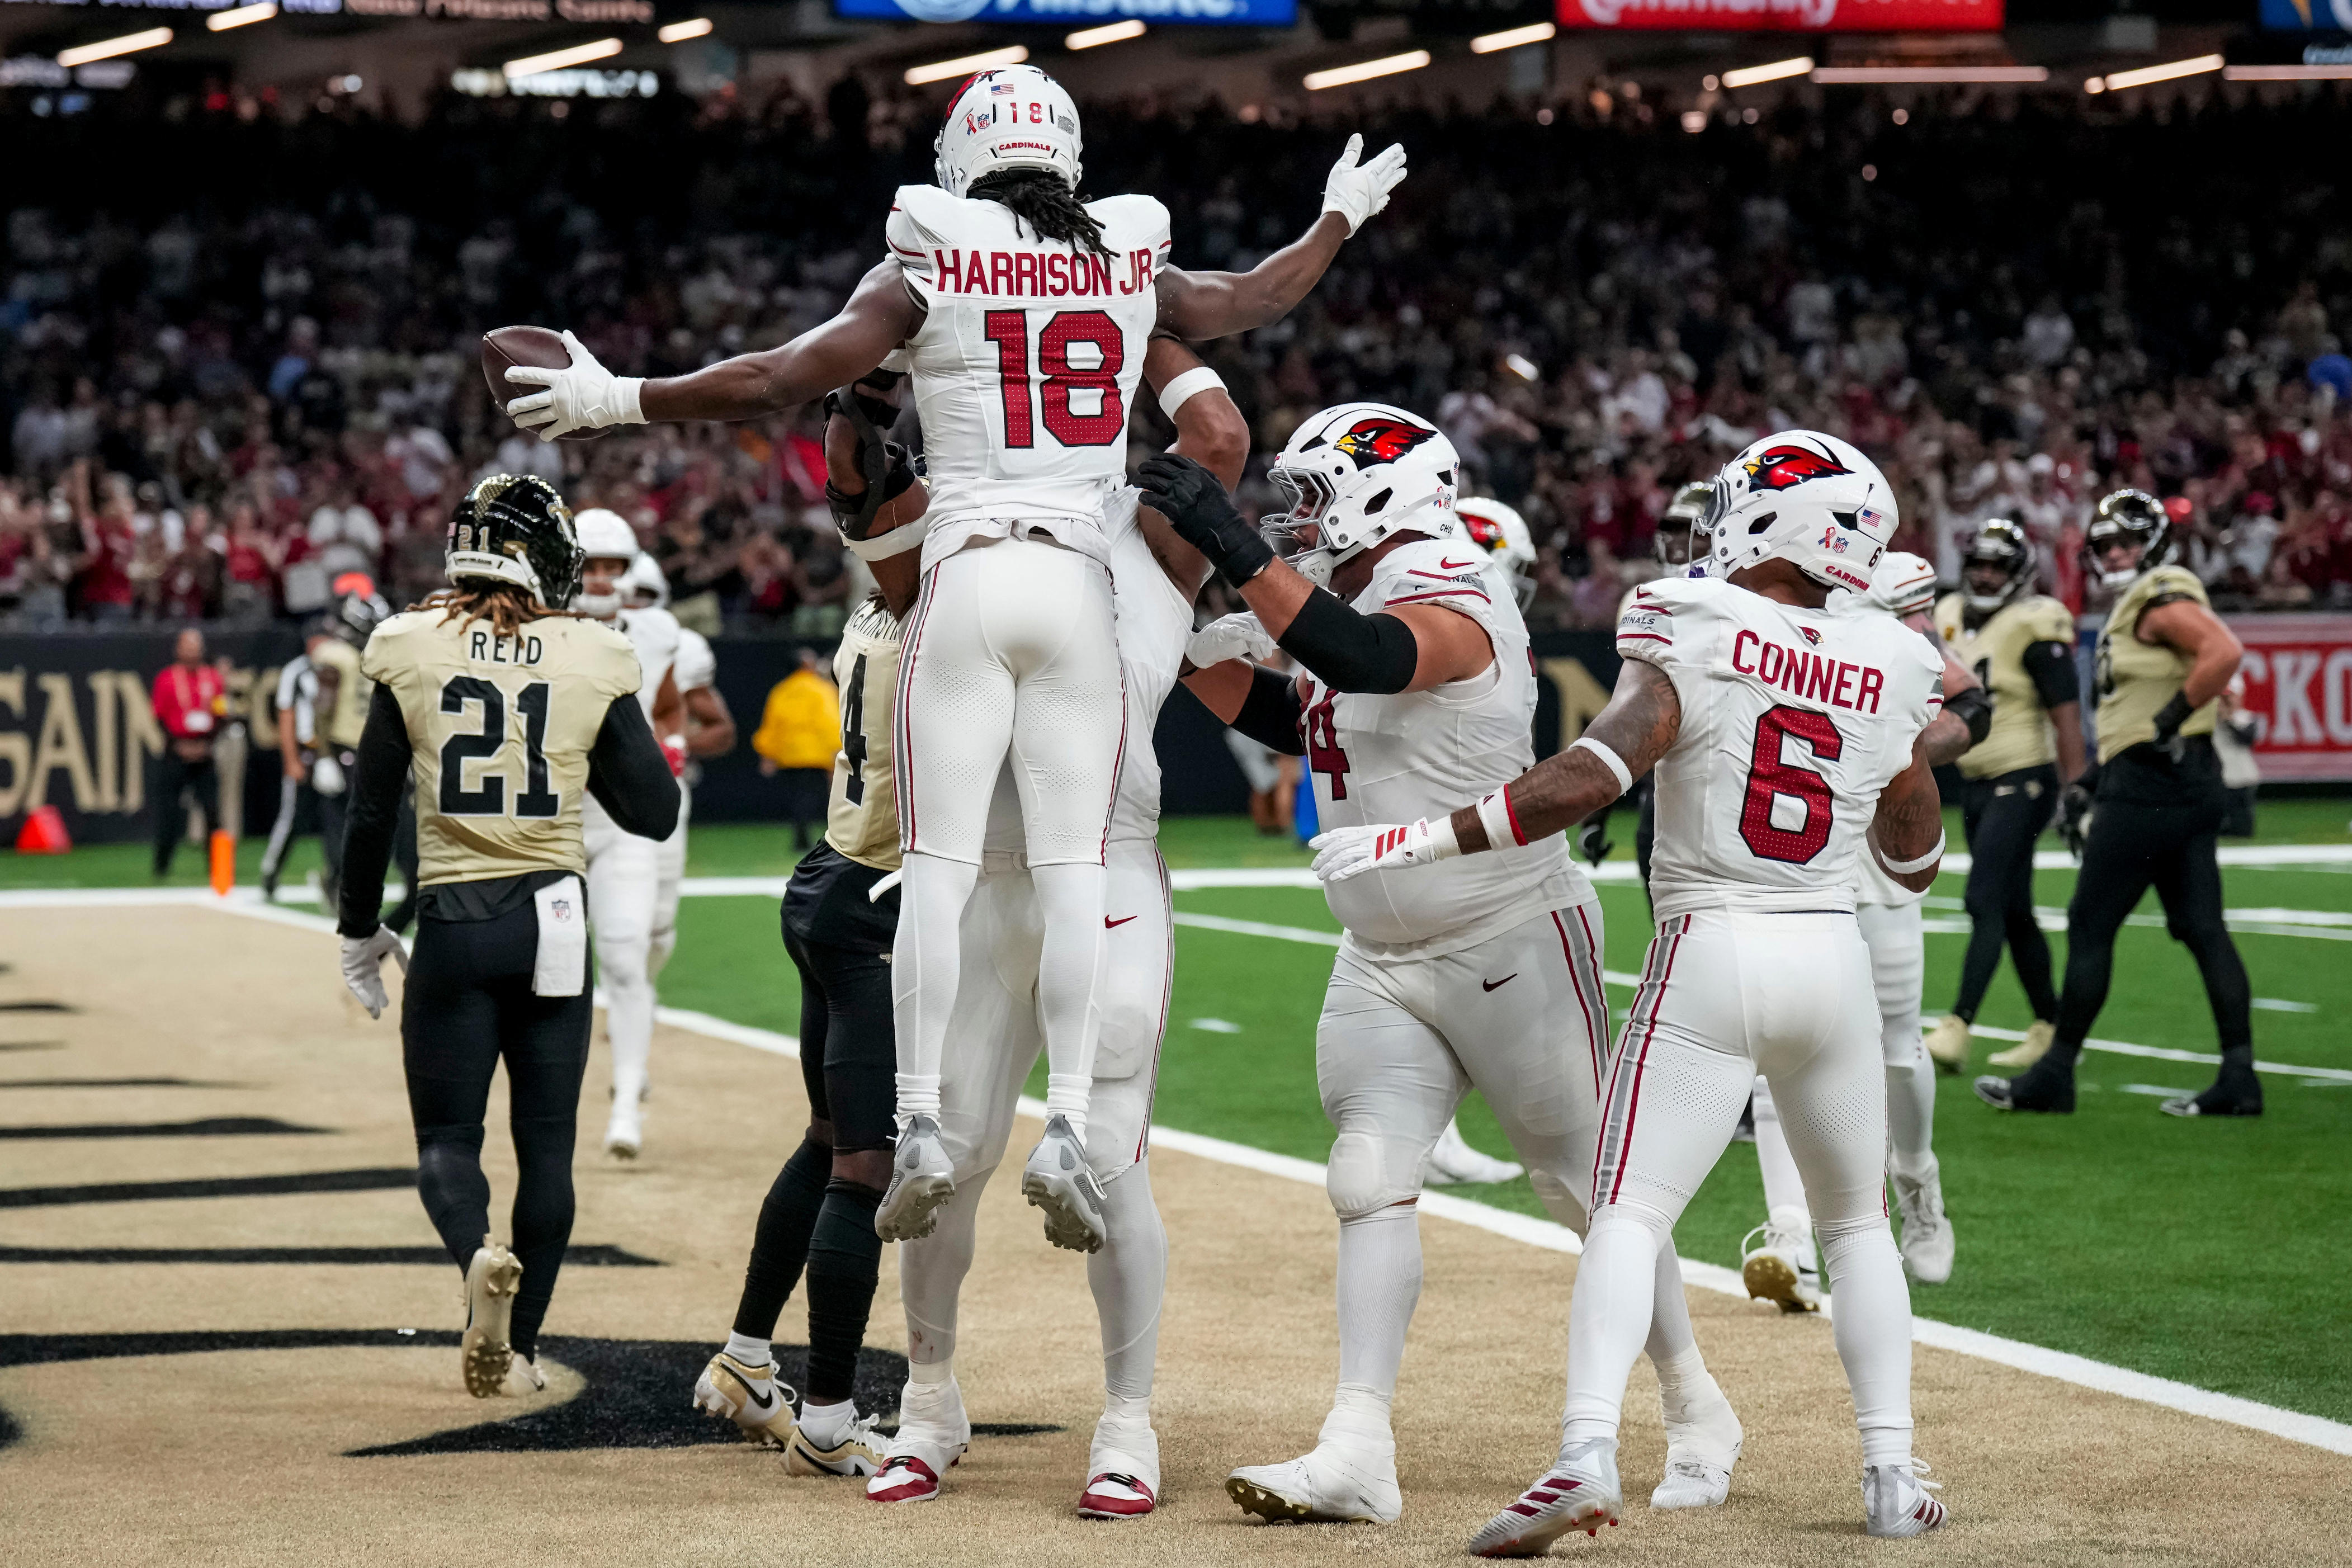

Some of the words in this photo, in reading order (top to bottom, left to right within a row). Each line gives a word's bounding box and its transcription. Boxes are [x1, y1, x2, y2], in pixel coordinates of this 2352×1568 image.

[979, 120, 989, 128] NFL
[1010, 102, 1042, 124] 18
[999, 142, 1051, 152] CARDINALS
[934, 248, 1113, 297] HARRISON
[1119, 247, 1154, 296] JR
[984, 309, 1125, 448] 18
[458, 524, 490, 554] 21
[1834, 542, 1845, 552] NFL
[1868, 546, 1882, 568] 6
[470, 631, 543, 665] REID
[1732, 629, 1884, 715] CONNER
[438, 673, 560, 819] 21
[1738, 703, 1843, 865] 6
